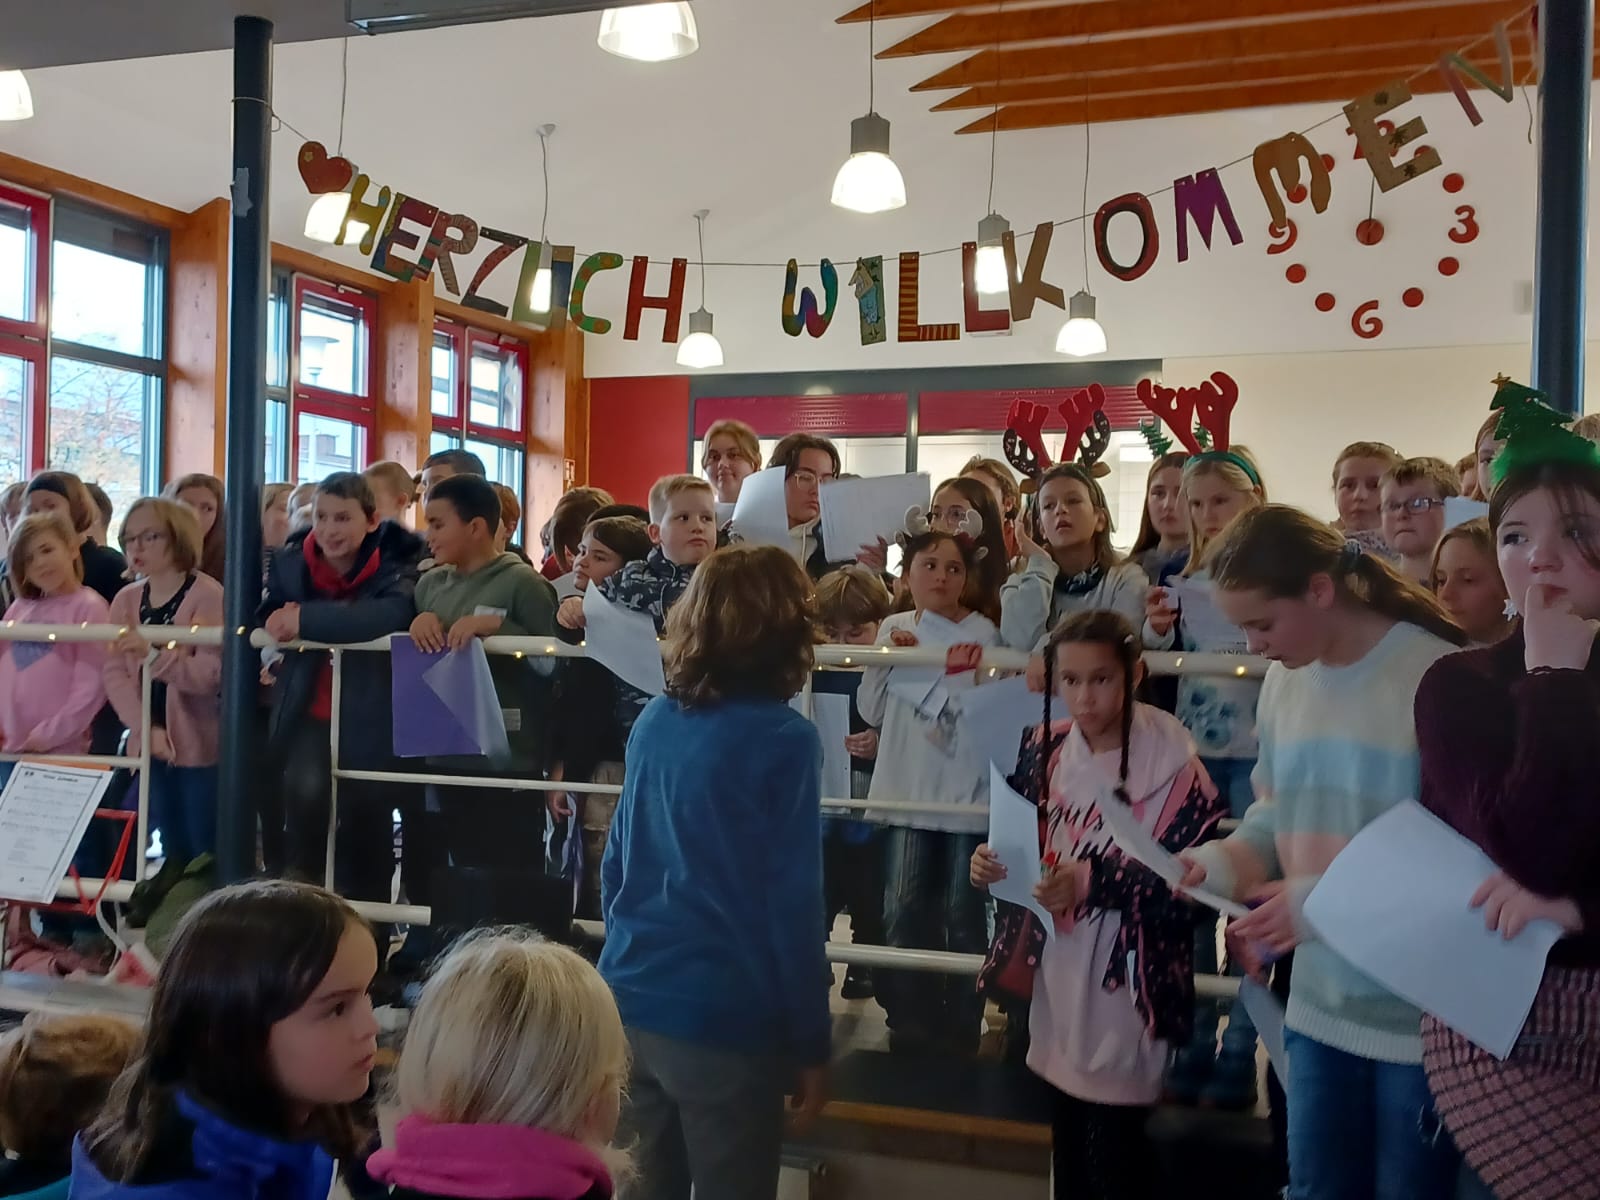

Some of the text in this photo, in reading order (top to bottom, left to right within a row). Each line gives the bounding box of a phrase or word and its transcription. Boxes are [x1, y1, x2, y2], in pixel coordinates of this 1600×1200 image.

[334, 20, 1514, 346] HERZLICH WILLKOMMEN
[1266, 217, 1298, 255] 9
[1448, 204, 1480, 244] 3
[1351, 299, 1384, 339] 6
